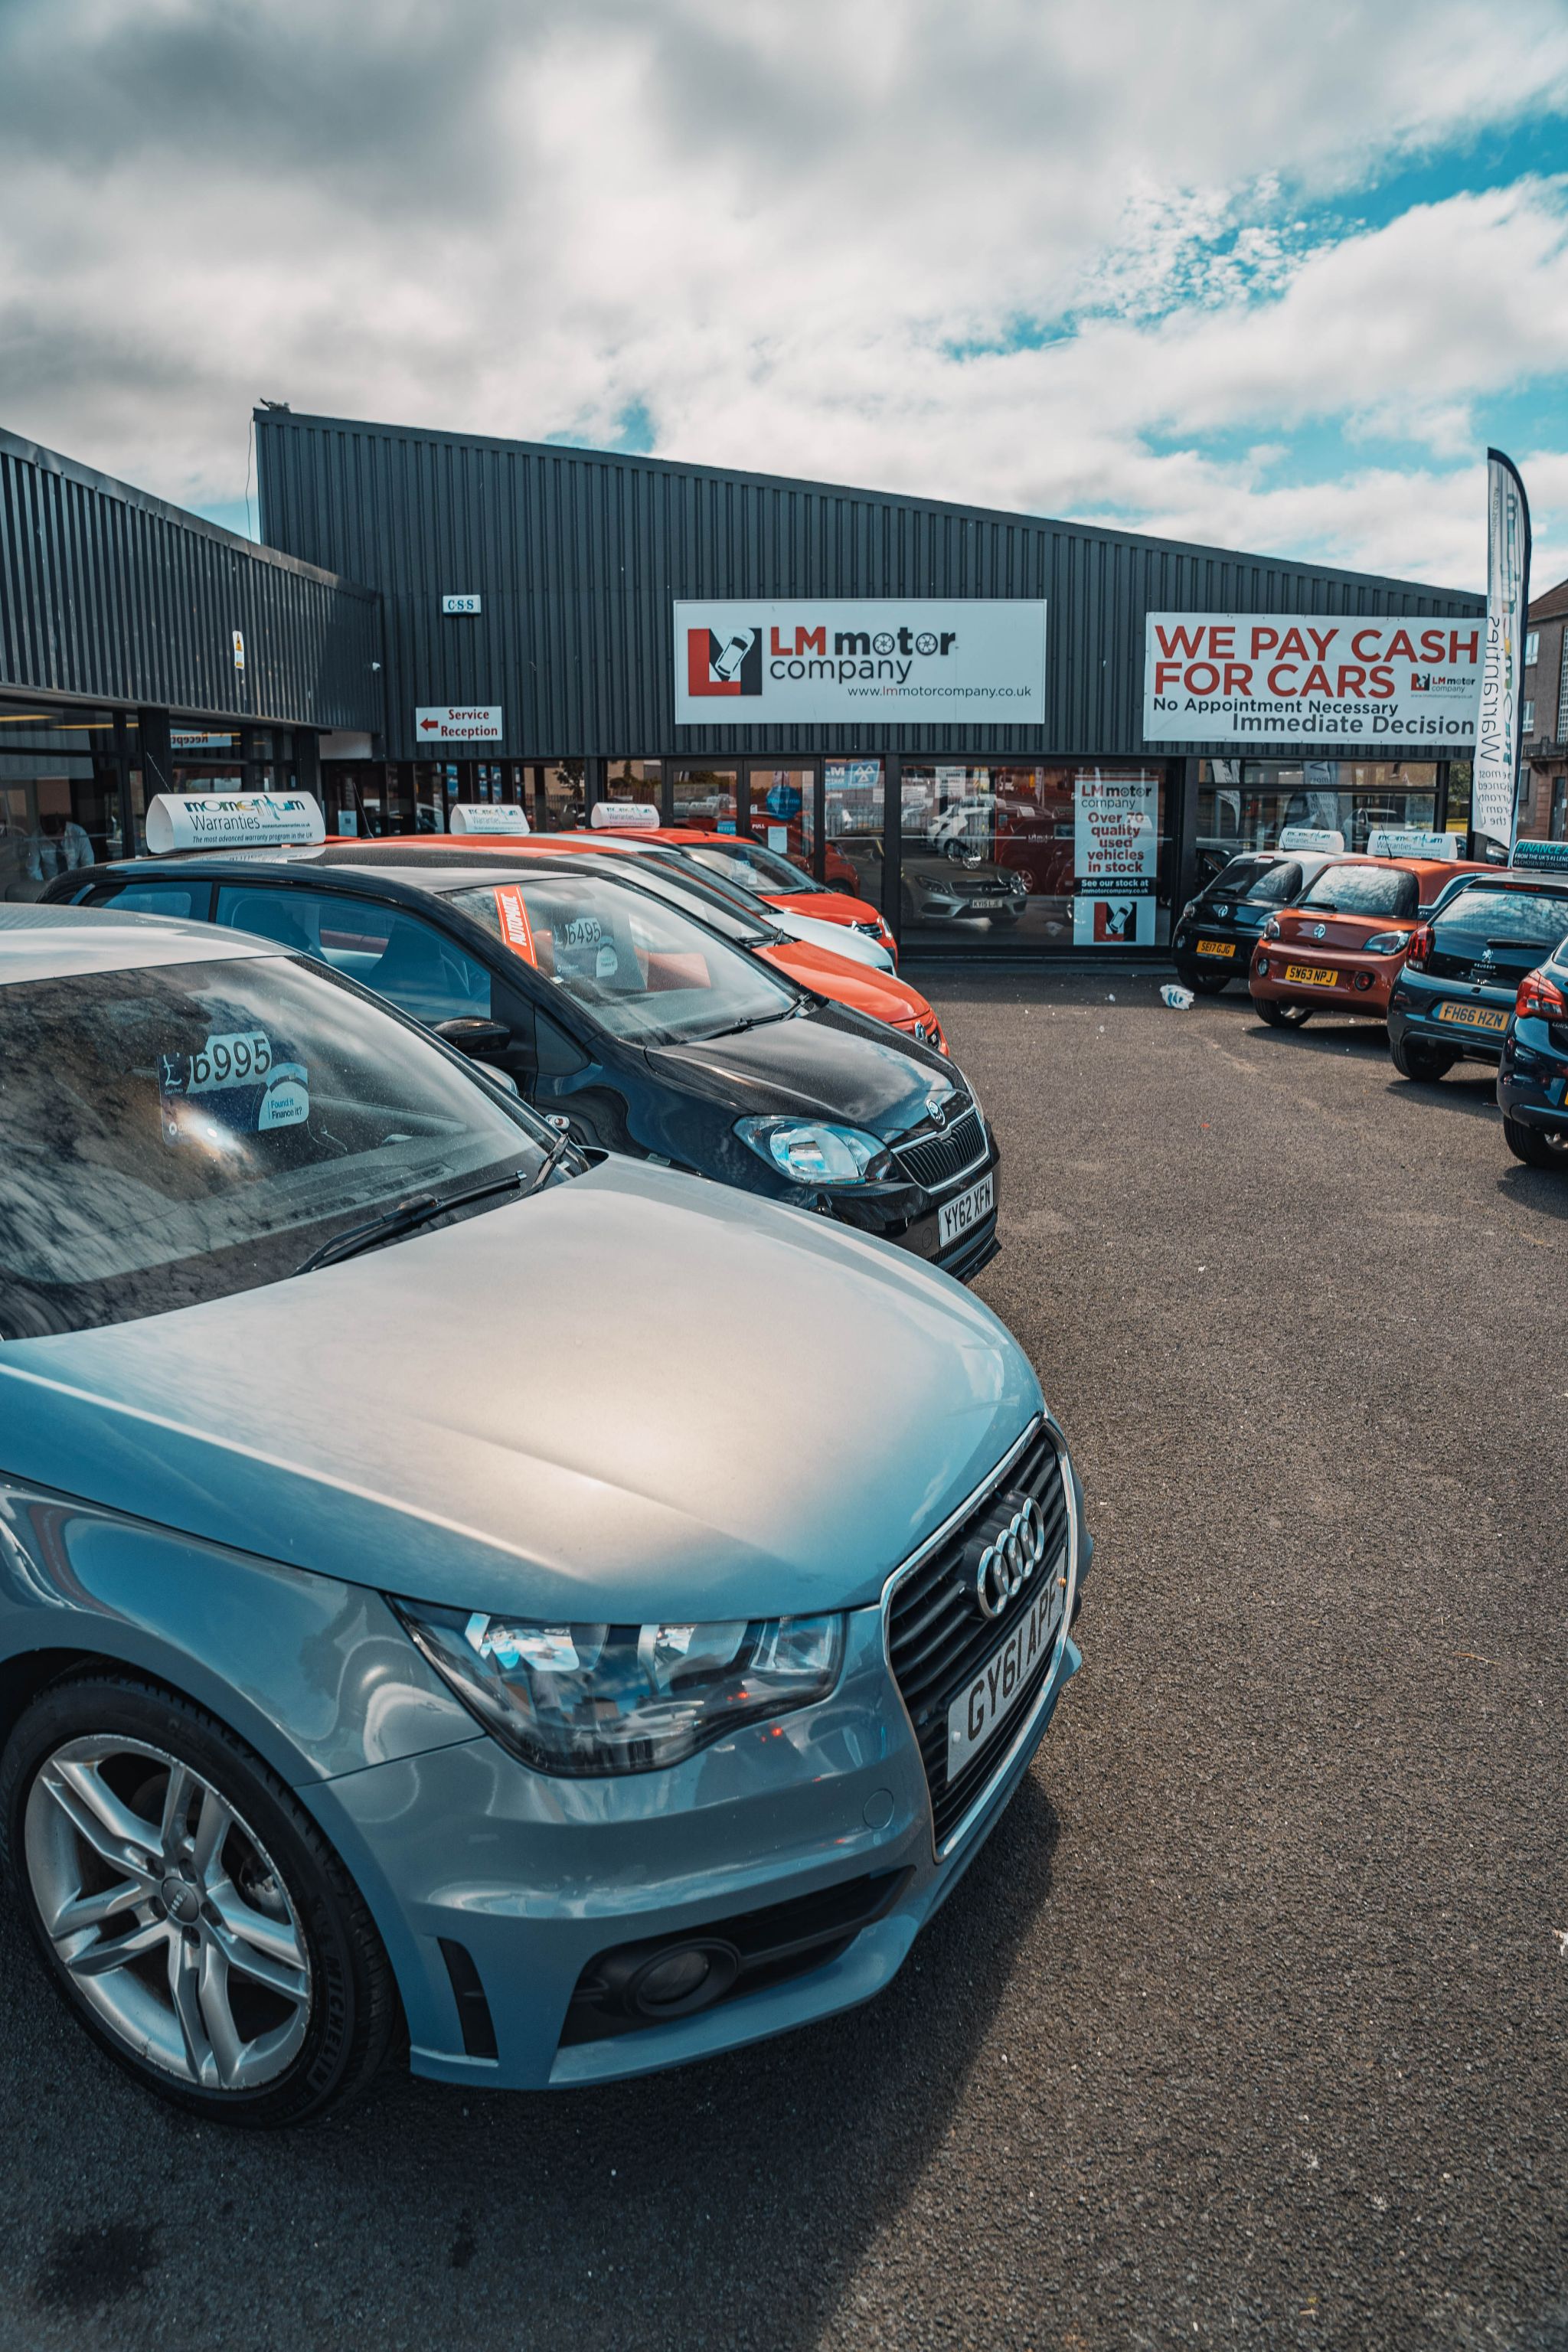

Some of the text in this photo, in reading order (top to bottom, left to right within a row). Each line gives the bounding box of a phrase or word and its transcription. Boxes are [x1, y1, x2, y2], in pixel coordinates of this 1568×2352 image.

[770, 626, 956, 656] LM motor
[1155, 626, 1478, 664] WE PAY CASH
[769, 657, 913, 684] company
[1155, 662, 1395, 699] FOR CARS
[1432, 677, 1446, 685] LM
[848, 686, 1031, 698] www.lmmotorcompany.co.uk
[1153, 698, 1398, 717] No Appointment Necessary
[449, 709, 489, 720] Service
[1233, 714, 1475, 736] Immediate Decision
[441, 725, 498, 740] Reception
[1082, 785, 1152, 797] LM motor
[1082, 798, 1135, 810] company
[189, 813, 260, 831] Warranties
[1088, 812, 1122, 824] Over
[245, 834, 268, 842] warranty
[269, 832, 290, 841] program
[1091, 825, 1140, 839] quality
[1099, 837, 1133, 848] used
[1517, 843, 1563, 854] FINANCE
[1087, 849, 1144, 861] vehicles
[1088, 861, 1143, 873] in stock
[1081, 879, 1097, 887] See
[500, 893, 528, 946] AUTOMATIC
[567, 921, 602, 945] 6495
[1200, 942, 1231, 955] SE17 GJG
[1289, 968, 1334, 983] SW63 NPJ
[1444, 1005, 1504, 1027] FH66 HZN
[192, 1038, 270, 1083] 6995
[271, 1098, 289, 1109] Found
[289, 1097, 294, 1106] it
[272, 1109, 294, 1120] Finance
[968, 1629, 1022, 1741] GY61
[1027, 1567, 1058, 1666] APF
